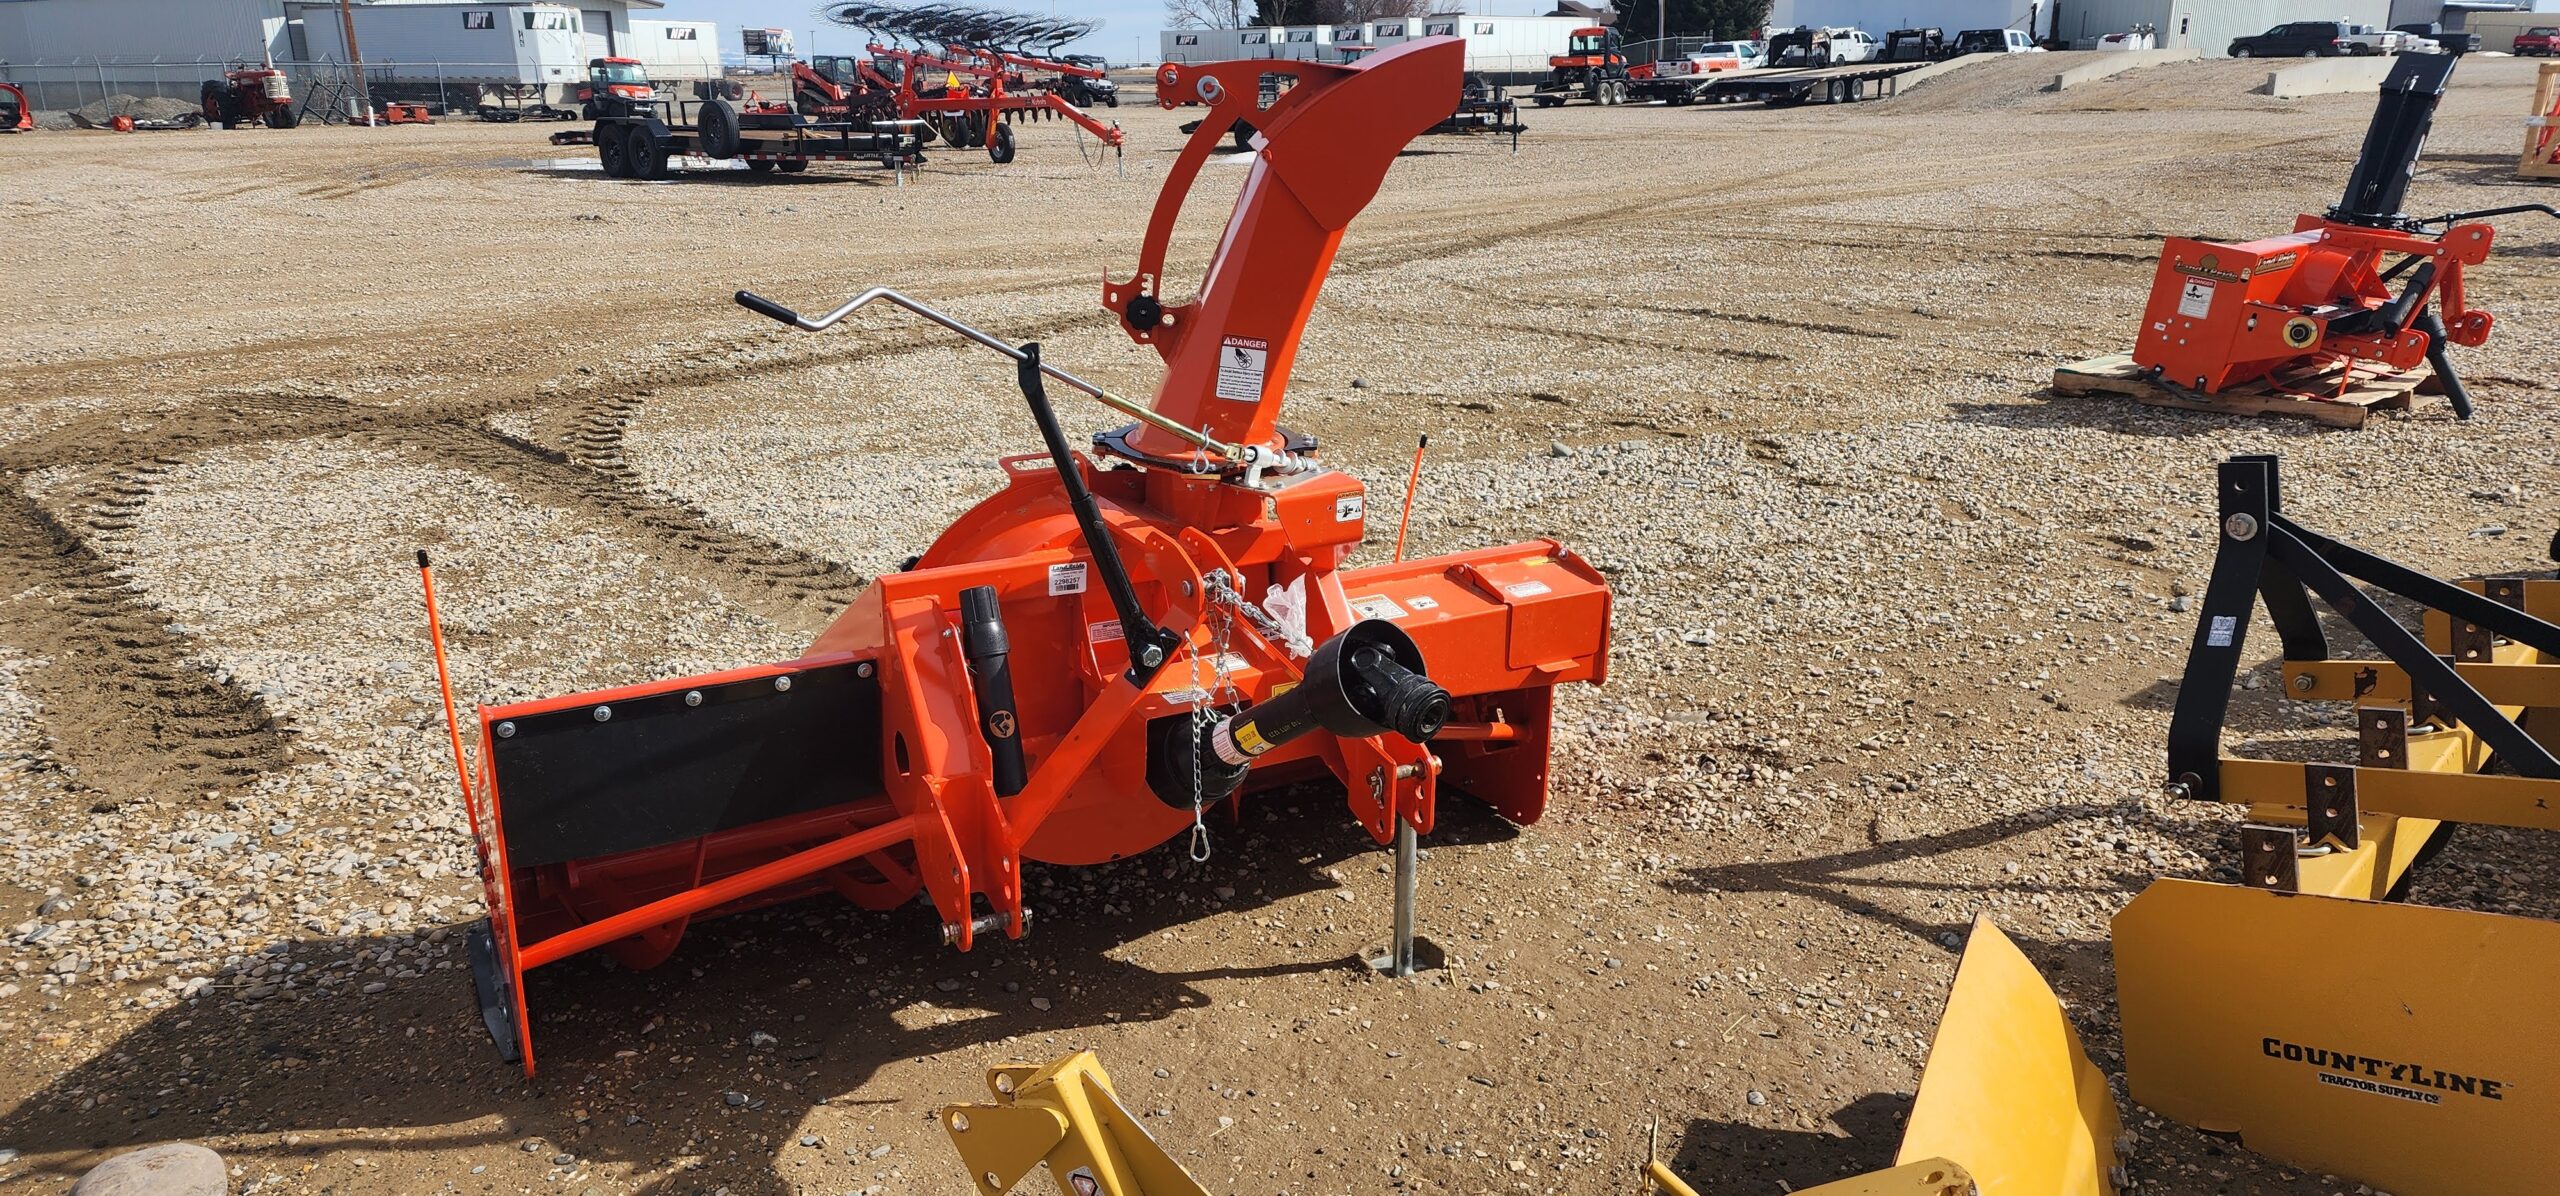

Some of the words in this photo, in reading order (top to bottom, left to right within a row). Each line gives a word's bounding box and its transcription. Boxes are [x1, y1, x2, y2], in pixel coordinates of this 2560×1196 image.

[467, 12, 489, 28] NPT
[532, 12, 564, 29] NPT
[670, 28, 692, 39] NPT
[1379, 25, 1400, 36] NPT
[1429, 24, 1449, 35] NPT
[1476, 23, 1491, 33] NPT
[1179, 35, 1195, 45] NPT
[1244, 33, 1263, 44] NPT
[1291, 32, 1310, 42] NPT
[1337, 29, 1356, 40] NPT
[1231, 337, 1268, 349] DANGER
[2262, 1037, 2503, 1100] COUNTYLINE
[2319, 1073, 2378, 1092] TRACTOR
[2379, 1083, 2424, 1102] SUPPLY
